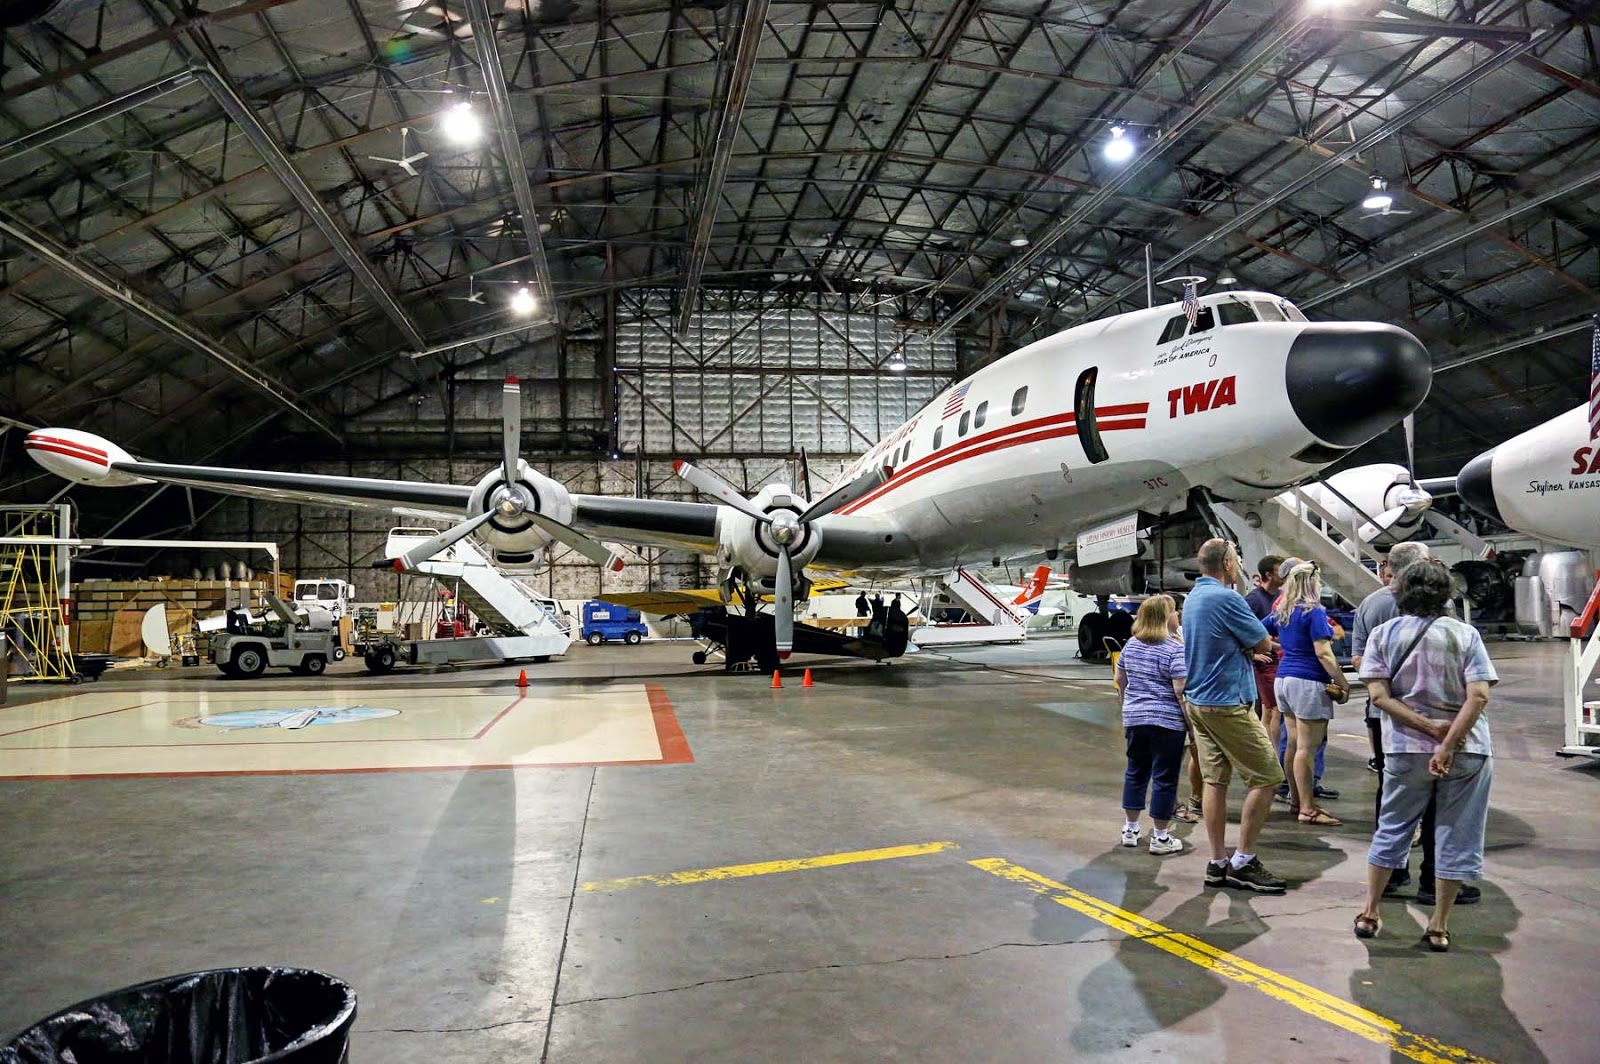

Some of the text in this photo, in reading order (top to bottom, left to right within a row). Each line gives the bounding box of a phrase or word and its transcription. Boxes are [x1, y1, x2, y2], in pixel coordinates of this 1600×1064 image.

[1153, 358, 1167, 367] STAR
[1179, 347, 1210, 360] AMERICA
[1167, 375, 1237, 419] TWA
[1143, 476, 1168, 490] 37C
[1525, 480, 1600, 496] Skyliner KANSAS
